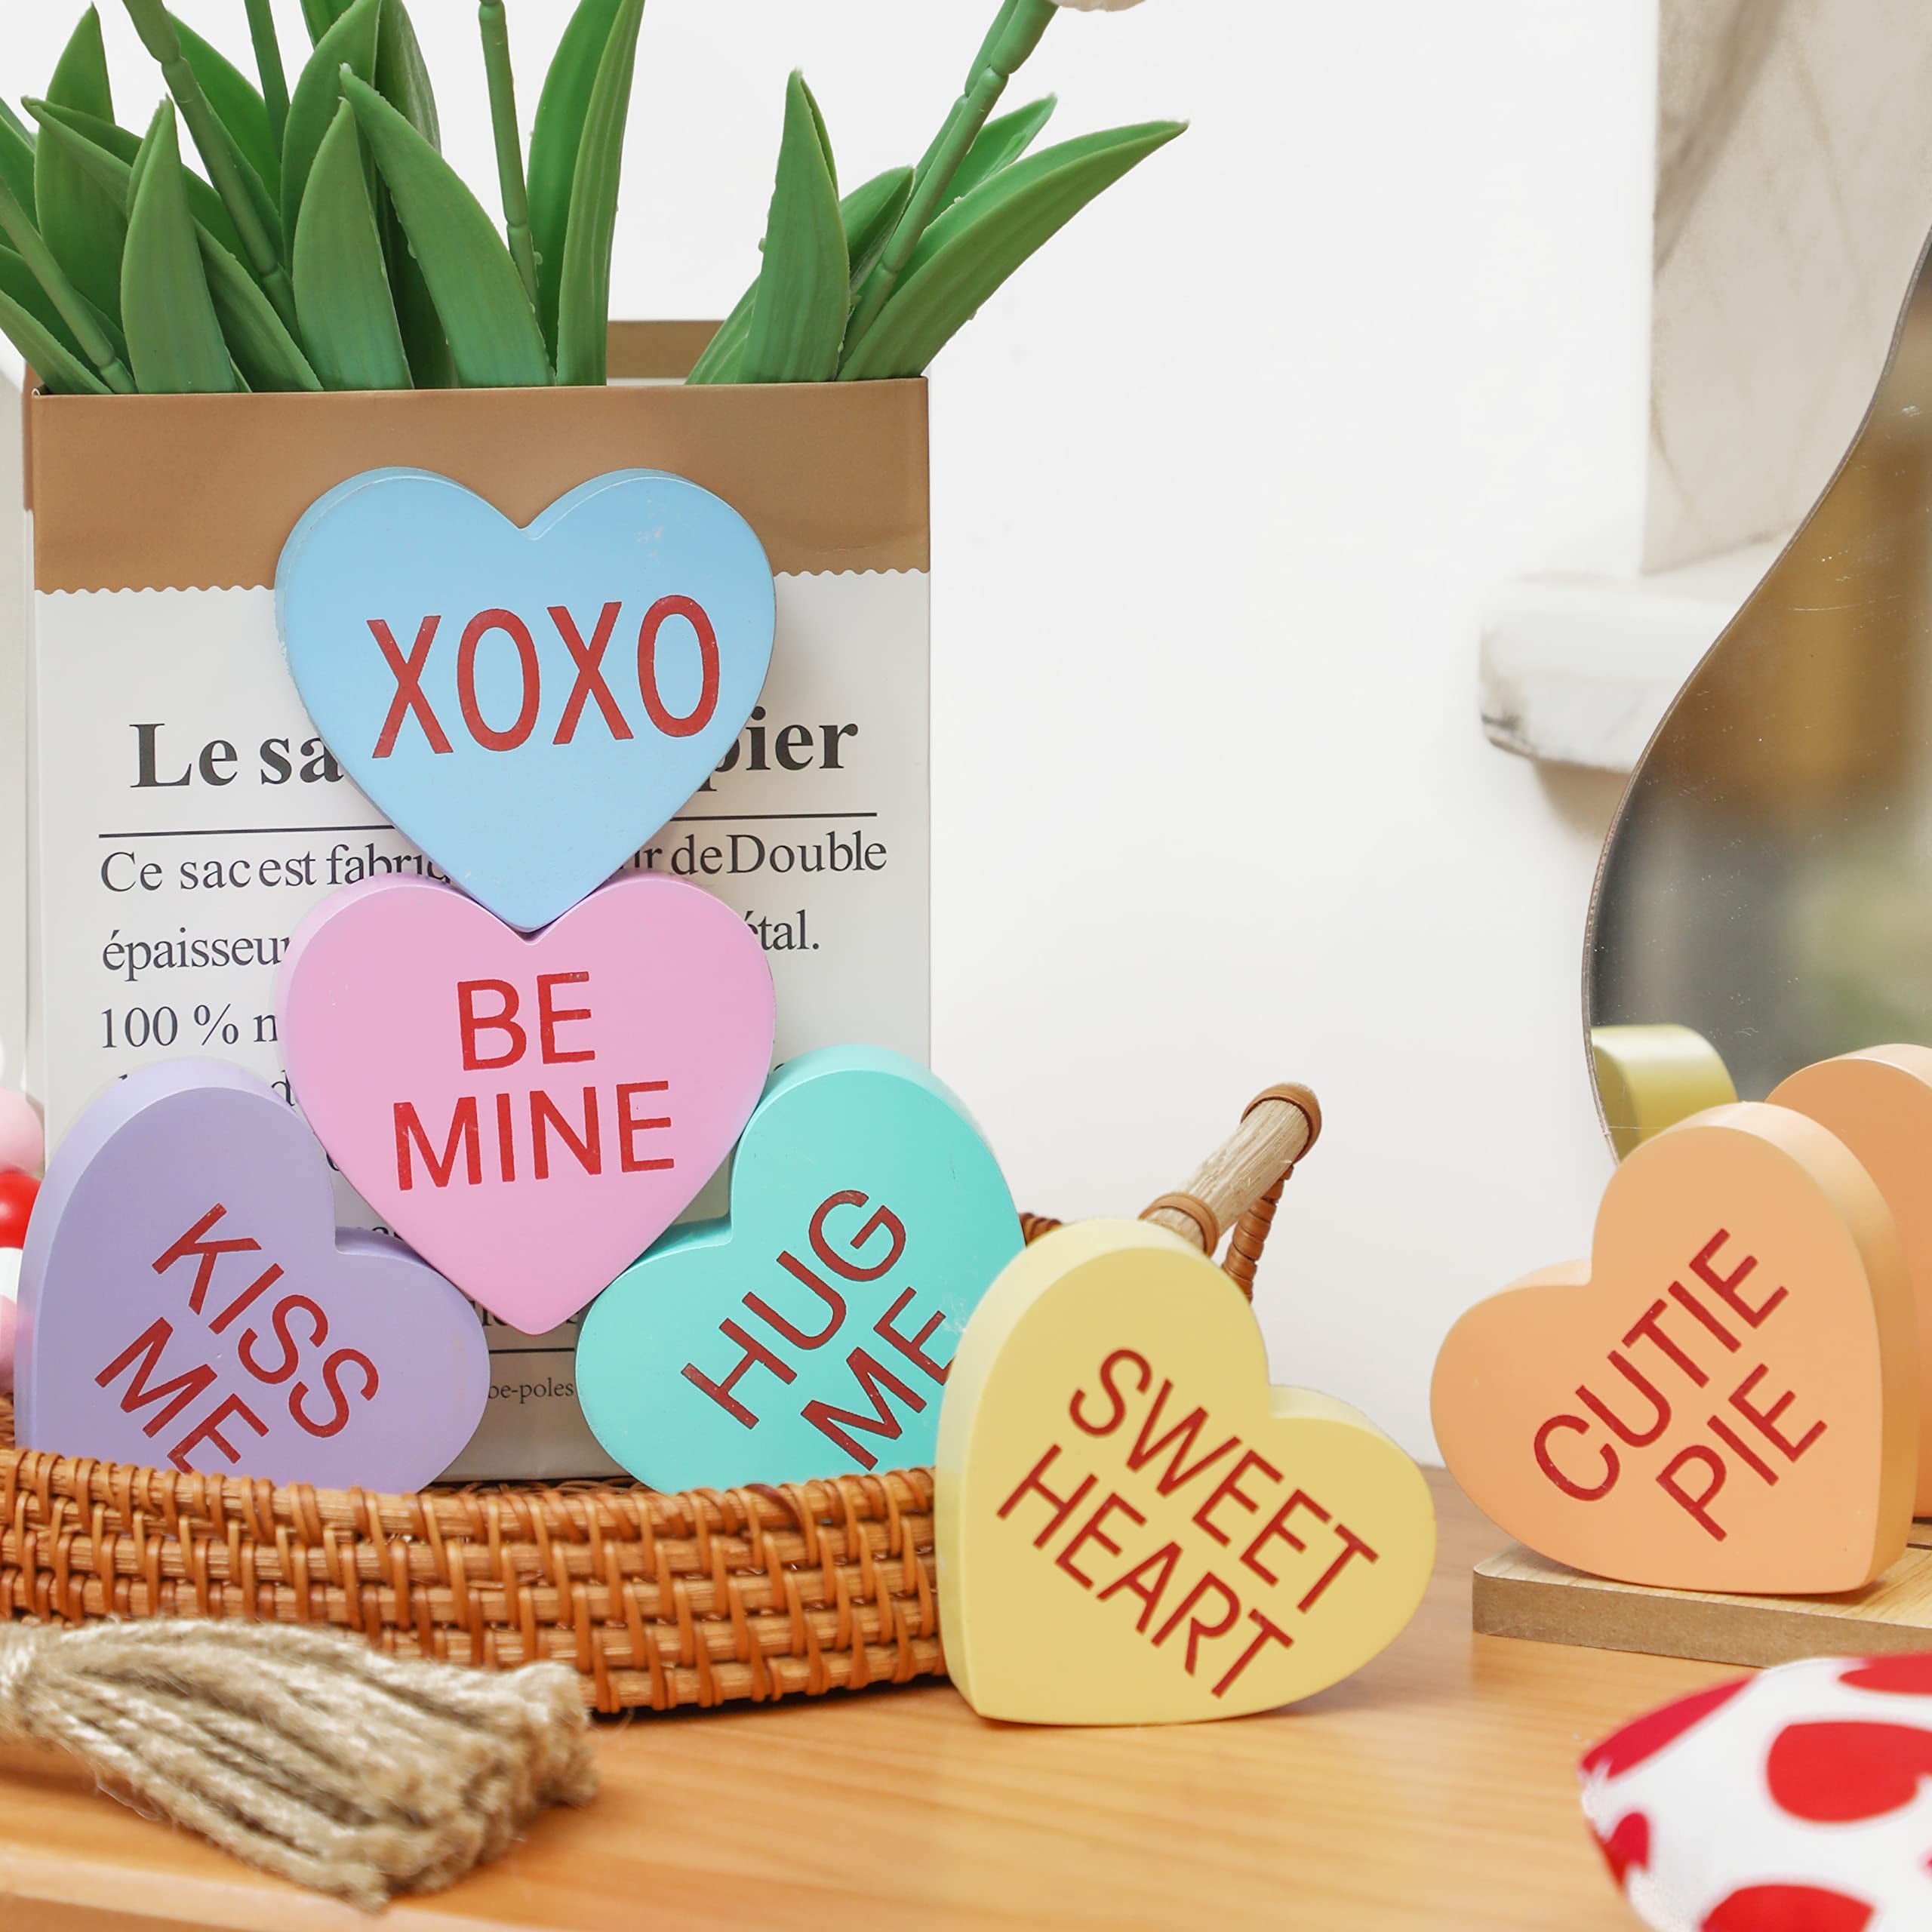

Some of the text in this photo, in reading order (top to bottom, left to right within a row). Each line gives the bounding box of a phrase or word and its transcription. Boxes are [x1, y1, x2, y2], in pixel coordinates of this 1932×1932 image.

[129, 723, 238, 788] Le
[367, 595, 720, 758] XOXO
[100, 851, 163, 892] Ce
[180, 859, 251, 890] sac
[259, 851, 318, 887] est
[671, 833, 724, 875] de
[726, 830, 888, 874] Double
[102, 1006, 179, 1049] 100
[193, 1003, 239, 1046] %
[457, 971, 596, 1071] BE
[393, 1080, 675, 1191] MINE
[152, 1203, 380, 1438] KISS
[681, 1190, 906, 1429] HUG
[801, 1287, 957, 1471] ME
[1534, 1228, 1789, 1502] CUTIE
[95, 1317, 269, 1474] ME
[1069, 1348, 1380, 1614] SWEET
[1655, 1363, 1828, 1542] PIE
[996, 1444, 1294, 1698] HEART
